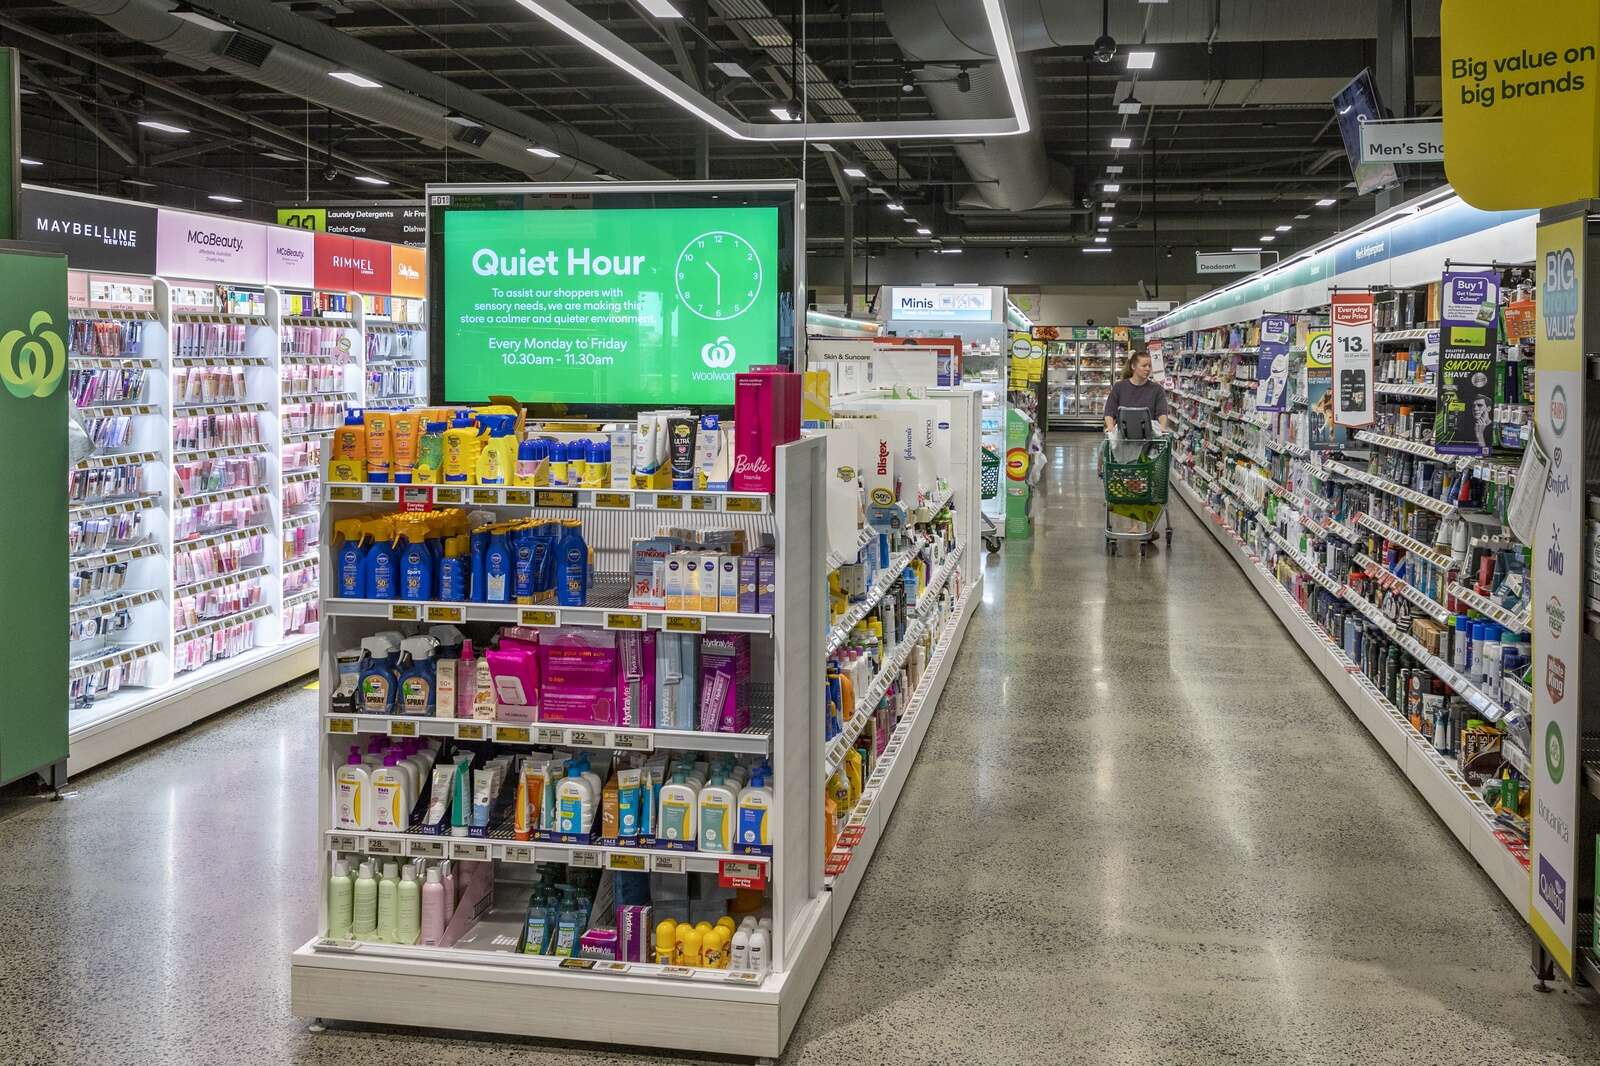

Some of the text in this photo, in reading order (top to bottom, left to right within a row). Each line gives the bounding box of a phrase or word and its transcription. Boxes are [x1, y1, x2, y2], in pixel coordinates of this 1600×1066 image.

[1451, 45, 1595, 81] Big value on
[1461, 72, 1585, 107] big brands
[1369, 142, 1414, 155] Men's
[327, 210, 355, 221] Laundry
[356, 210, 394, 221] Detergents
[403, 210, 414, 218] Air
[37, 217, 137, 242] MAYBELLINE
[103, 238, 136, 248] NEW YORK
[714, 235, 723, 243] 12
[333, 255, 375, 271] RIMMEL
[472, 247, 646, 276] Quiet Hour
[684, 254, 694, 262] 10
[747, 253, 753, 261] 2
[1199, 262, 1237, 271] Deodorant
[1546, 251, 1575, 292] BIG
[678, 272, 685, 280] 9
[752, 272, 759, 280] 3
[1457, 280, 1484, 291] Buy 1
[491, 287, 624, 300] To assist our shoppers with
[684, 291, 691, 299] 8
[474, 303, 512, 313] sensory
[514, 300, 547, 311] needs,
[548, 302, 563, 311] we
[583, 301, 621, 313] making
[623, 300, 646, 311] this
[734, 304, 740, 312] 5
[901, 297, 934, 309] Minis
[715, 309, 722, 317] 6
[1337, 306, 1368, 315] Everyday
[460, 314, 485, 324] store
[495, 313, 530, 323] calmer
[531, 313, 552, 323] and
[553, 313, 589, 326] quieter
[488, 337, 628, 352] Every Monday to Friday
[1337, 336, 1363, 353] $13
[502, 353, 554, 365] 10.30am
[564, 353, 614, 365] 11.30am
[823, 353, 837, 361] Skin
[844, 353, 871, 361] Suncare
[1444, 352, 1492, 360] UNBEATABLY
[1443, 360, 1492, 371] SMOOTH
[1551, 400, 1567, 421] FAIRY
[877, 438, 889, 476] Blistex
[734, 454, 771, 474] Barbie
[637, 550, 666, 558] STINGOSE
[1547, 549, 1564, 576] OMO
[407, 569, 421, 577] Sport
[702, 638, 734, 649] Hydralyte
[1548, 670, 1563, 696] King
[622, 687, 632, 727] Hydralyte
[1538, 798, 1569, 843] Botanica
[1540, 873, 1565, 920] Quilton
[582, 943, 612, 955] Hydralyte
